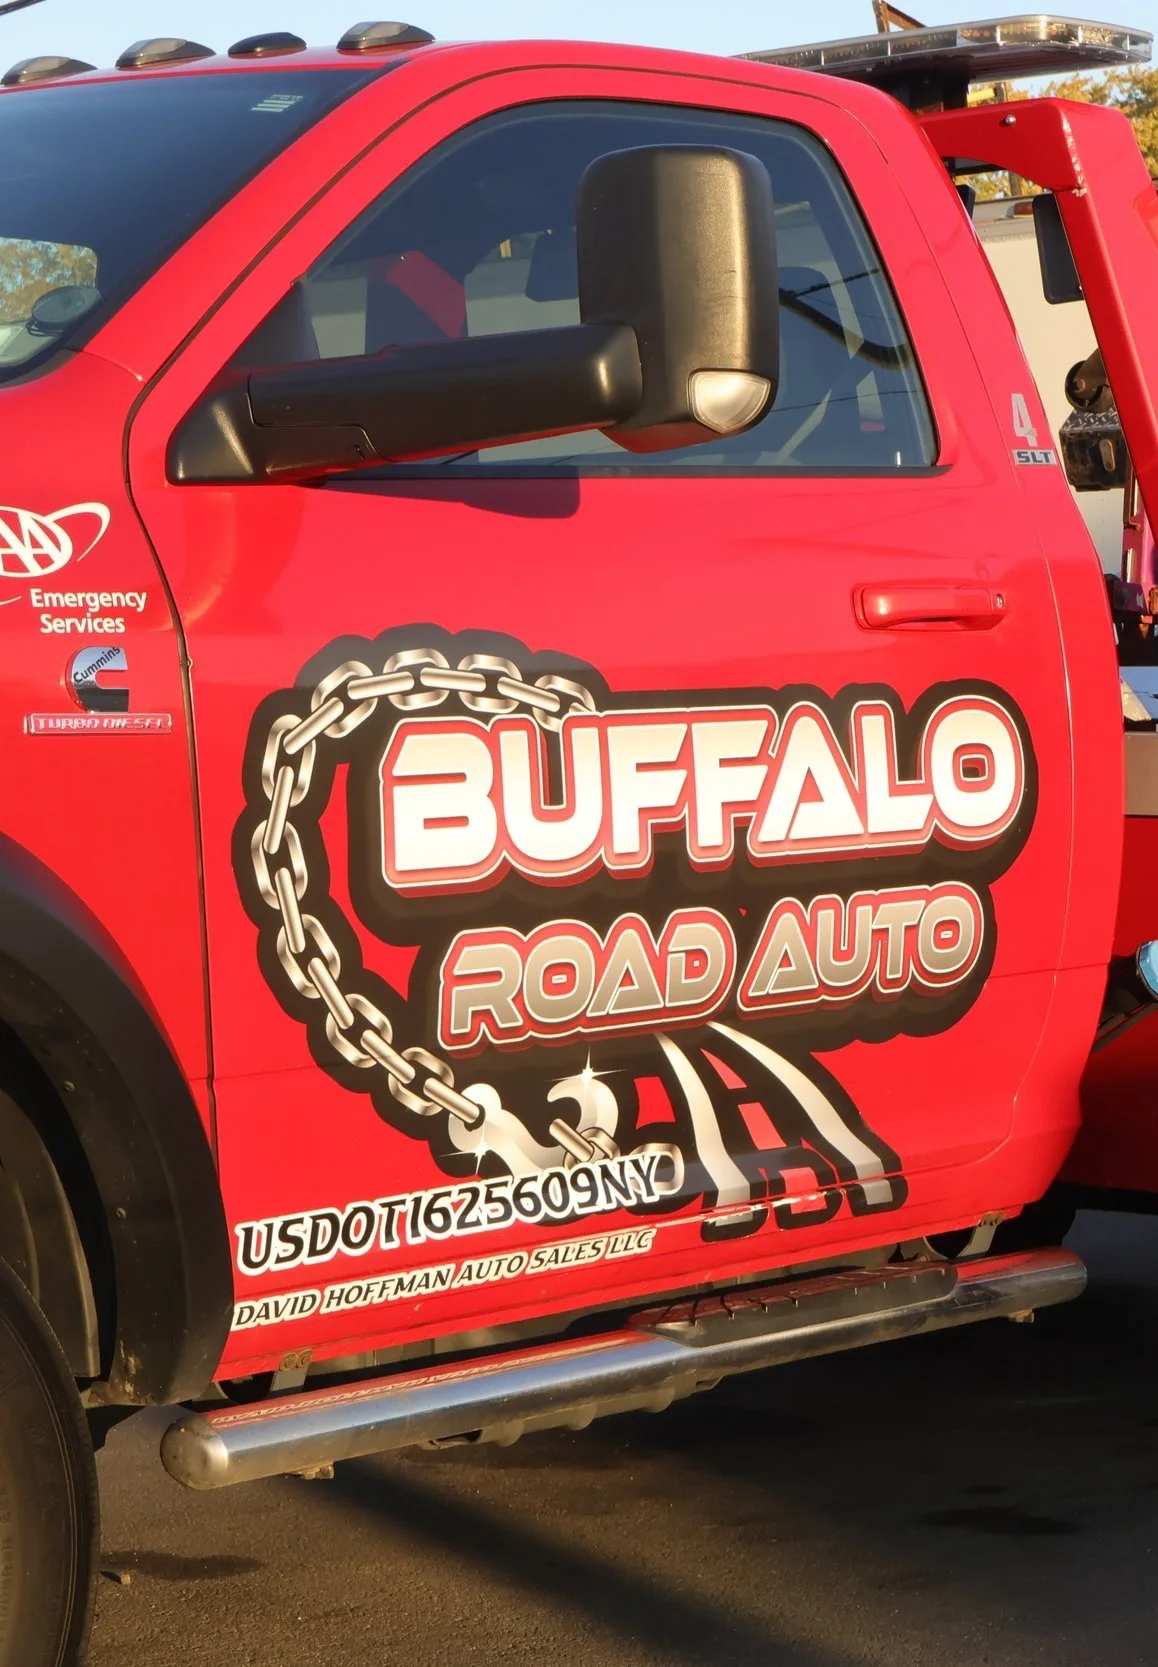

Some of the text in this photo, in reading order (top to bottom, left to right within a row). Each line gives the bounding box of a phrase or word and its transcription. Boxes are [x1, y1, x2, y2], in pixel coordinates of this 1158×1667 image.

[1011, 393, 1038, 447] 4
[1015, 450, 1052, 464] SLT
[30, 588, 147, 612] Emergency
[40, 613, 126, 634] Services
[72, 646, 122, 683] Cummins
[34, 717, 167, 730] TURBO DIESEL
[383, 697, 1022, 885] BUFFALO
[443, 887, 982, 1047] ROAD AUTO
[238, 1153, 660, 1272] USDOT1625609NY
[235, 1230, 655, 1329] DAVID HOFFMAN AUTO SALES LLC
